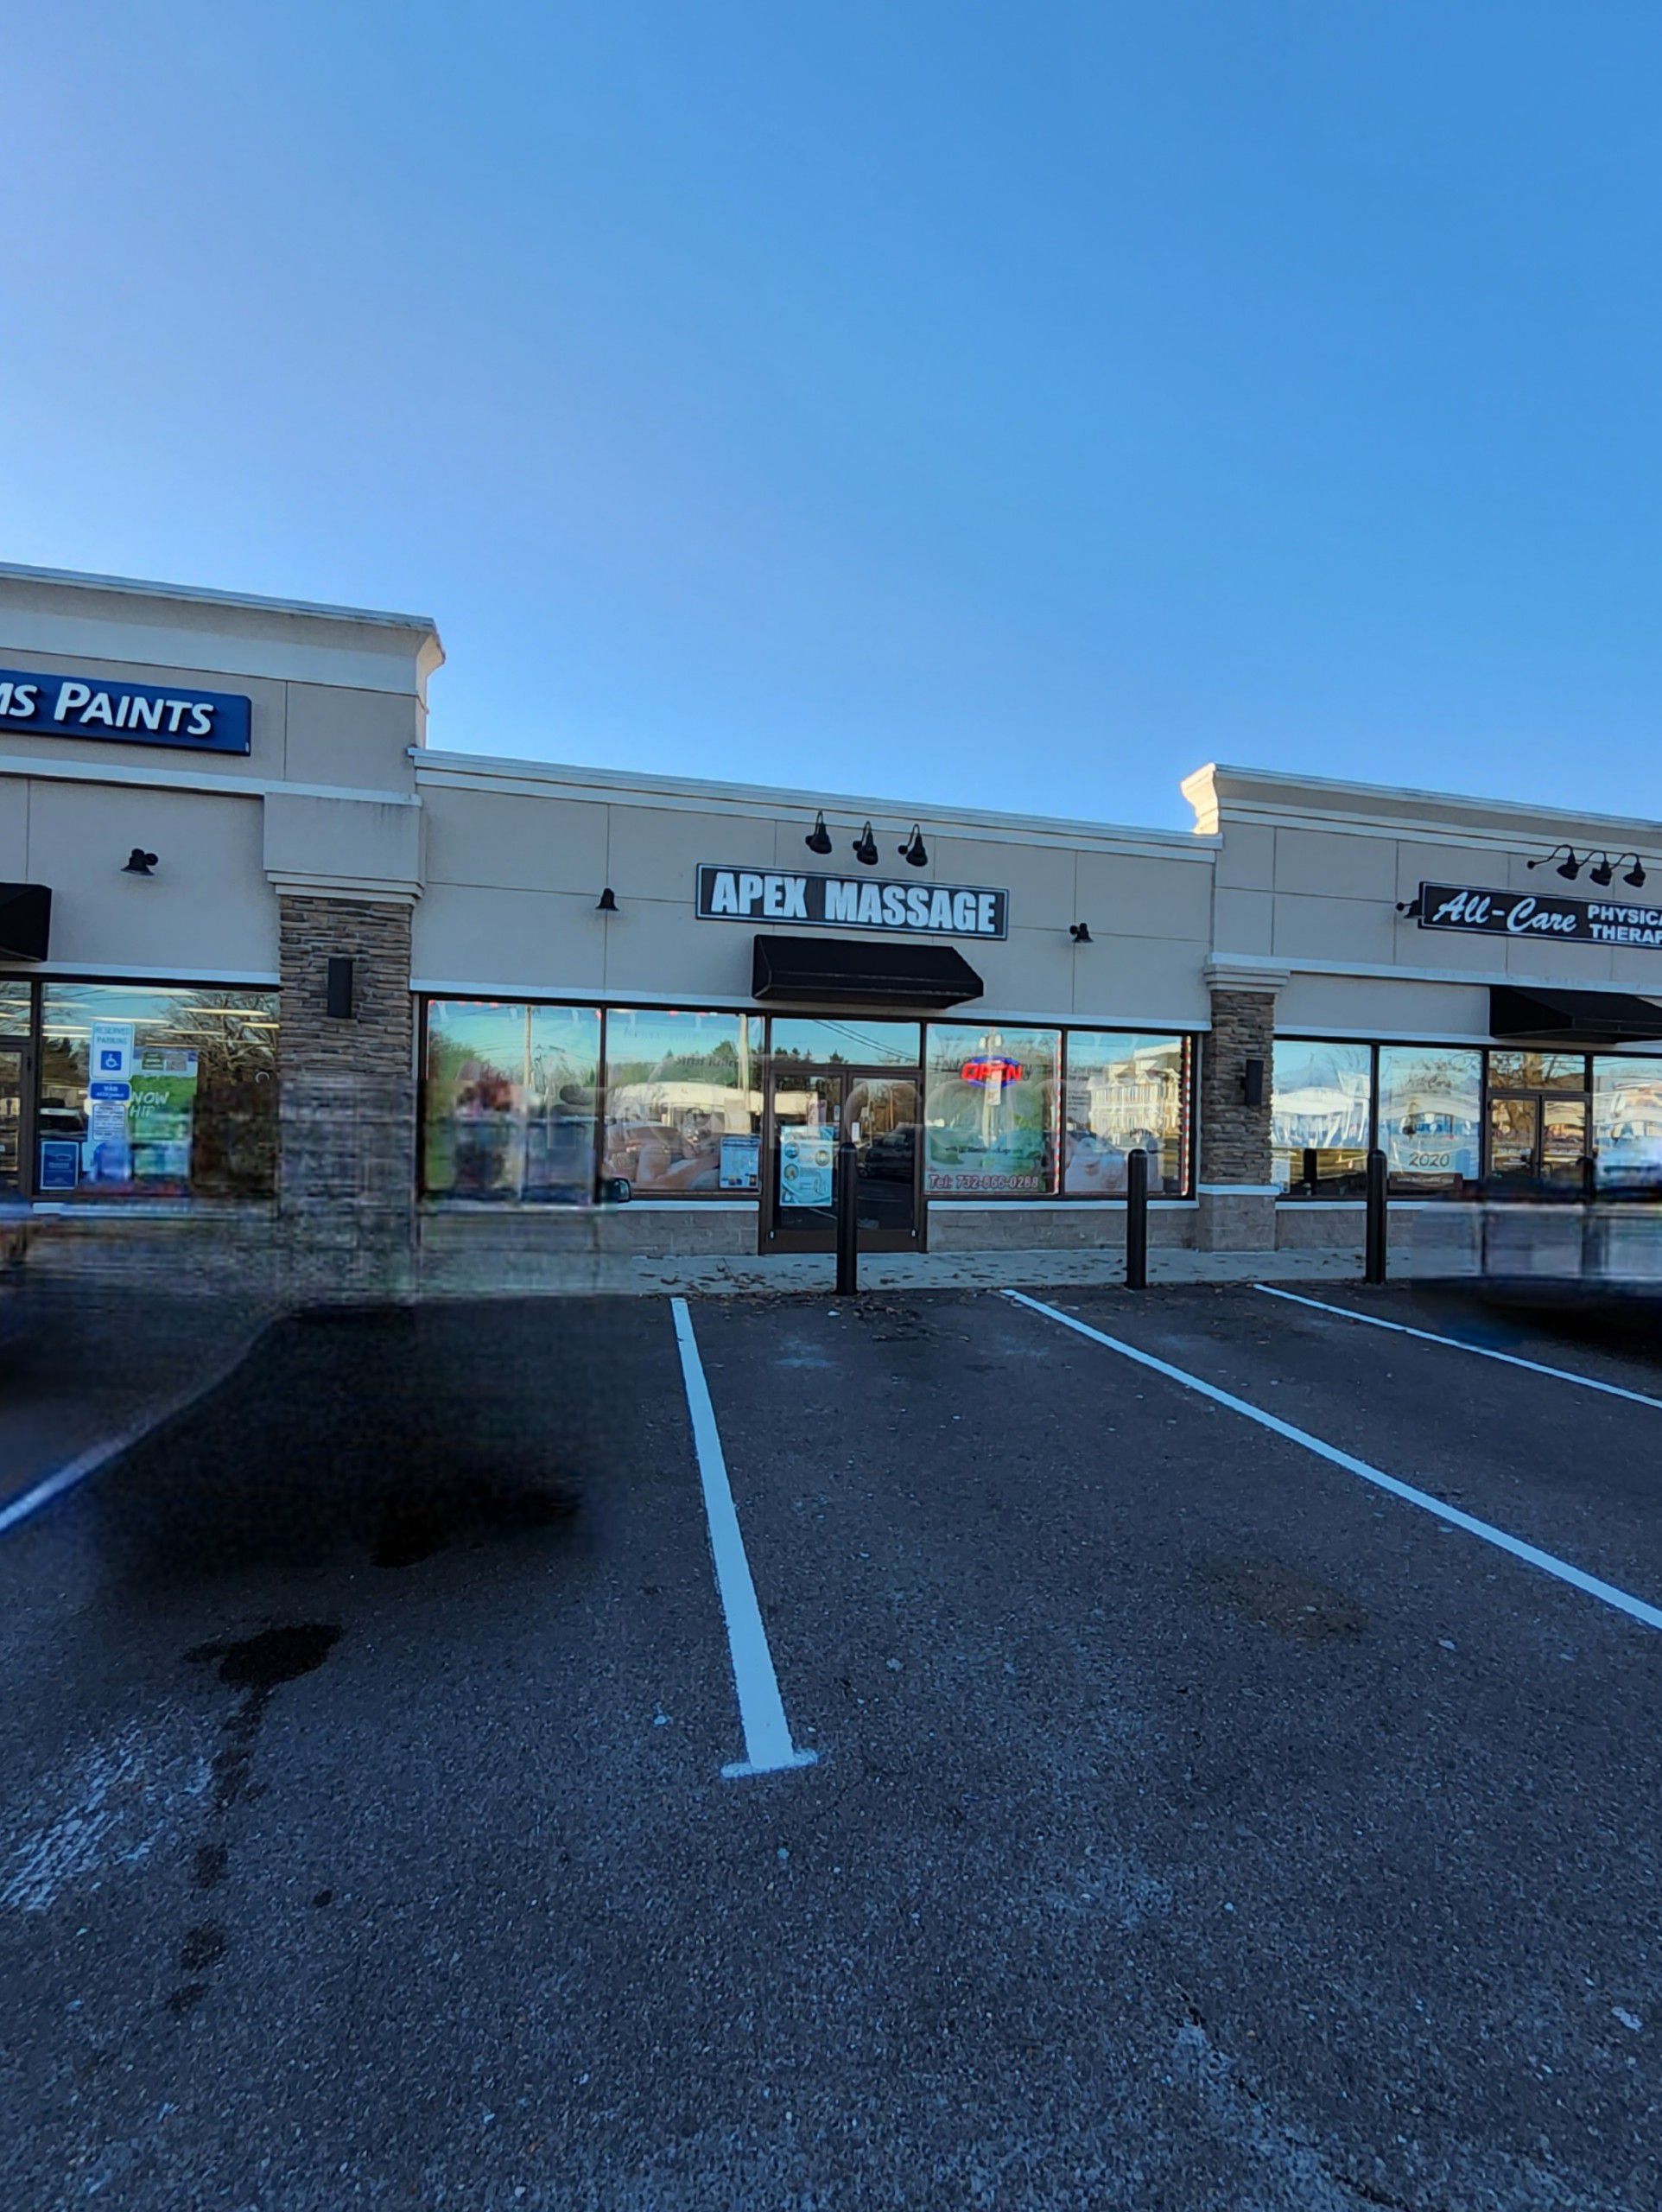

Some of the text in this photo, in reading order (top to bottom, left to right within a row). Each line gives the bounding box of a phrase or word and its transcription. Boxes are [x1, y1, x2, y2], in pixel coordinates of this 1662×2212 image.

[54, 681, 214, 735] PAINTS
[711, 872, 996, 933] APEX MASSAGE
[1432, 891, 1577, 932] All-Care
[131, 1091, 169, 1105] NOW
[1408, 1152, 1450, 1167] 2020
